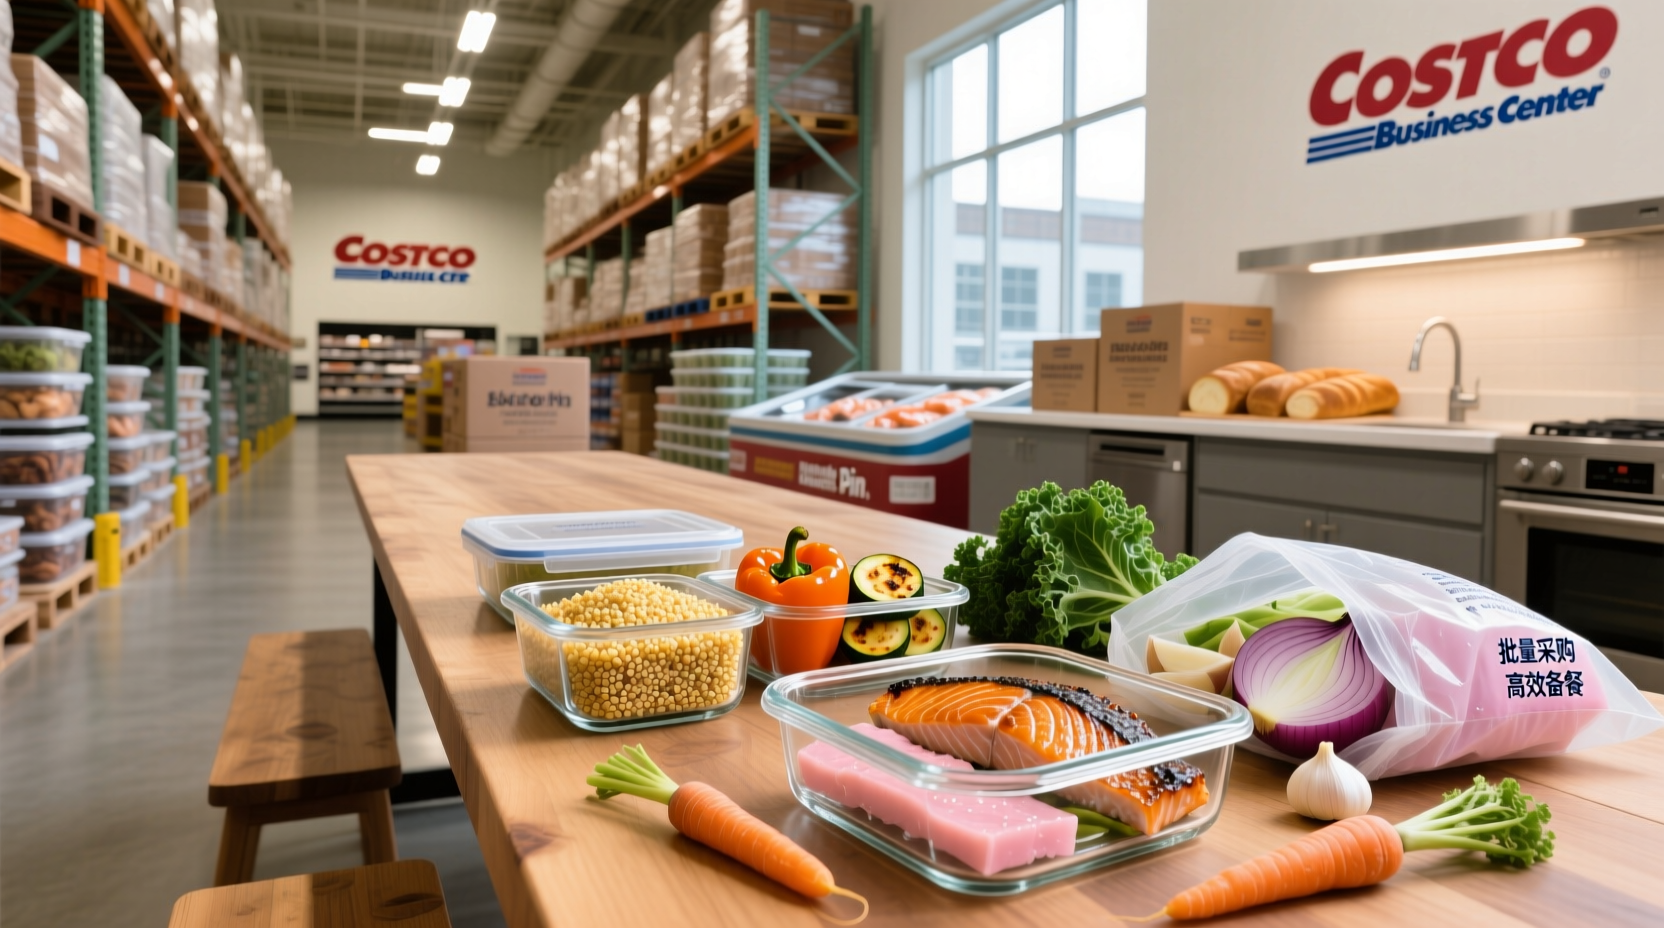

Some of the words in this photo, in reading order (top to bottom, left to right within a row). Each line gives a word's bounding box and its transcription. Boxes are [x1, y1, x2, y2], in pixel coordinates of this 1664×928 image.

[1309, 6, 1618, 126] COSTCO
[1374, 106, 1494, 149] Business
[1498, 84, 1604, 123] Center
[335, 236, 476, 268] COSTCO
[1498, 637, 1575, 664] 批量采购
[1505, 670, 1584, 699] 高效备餐
